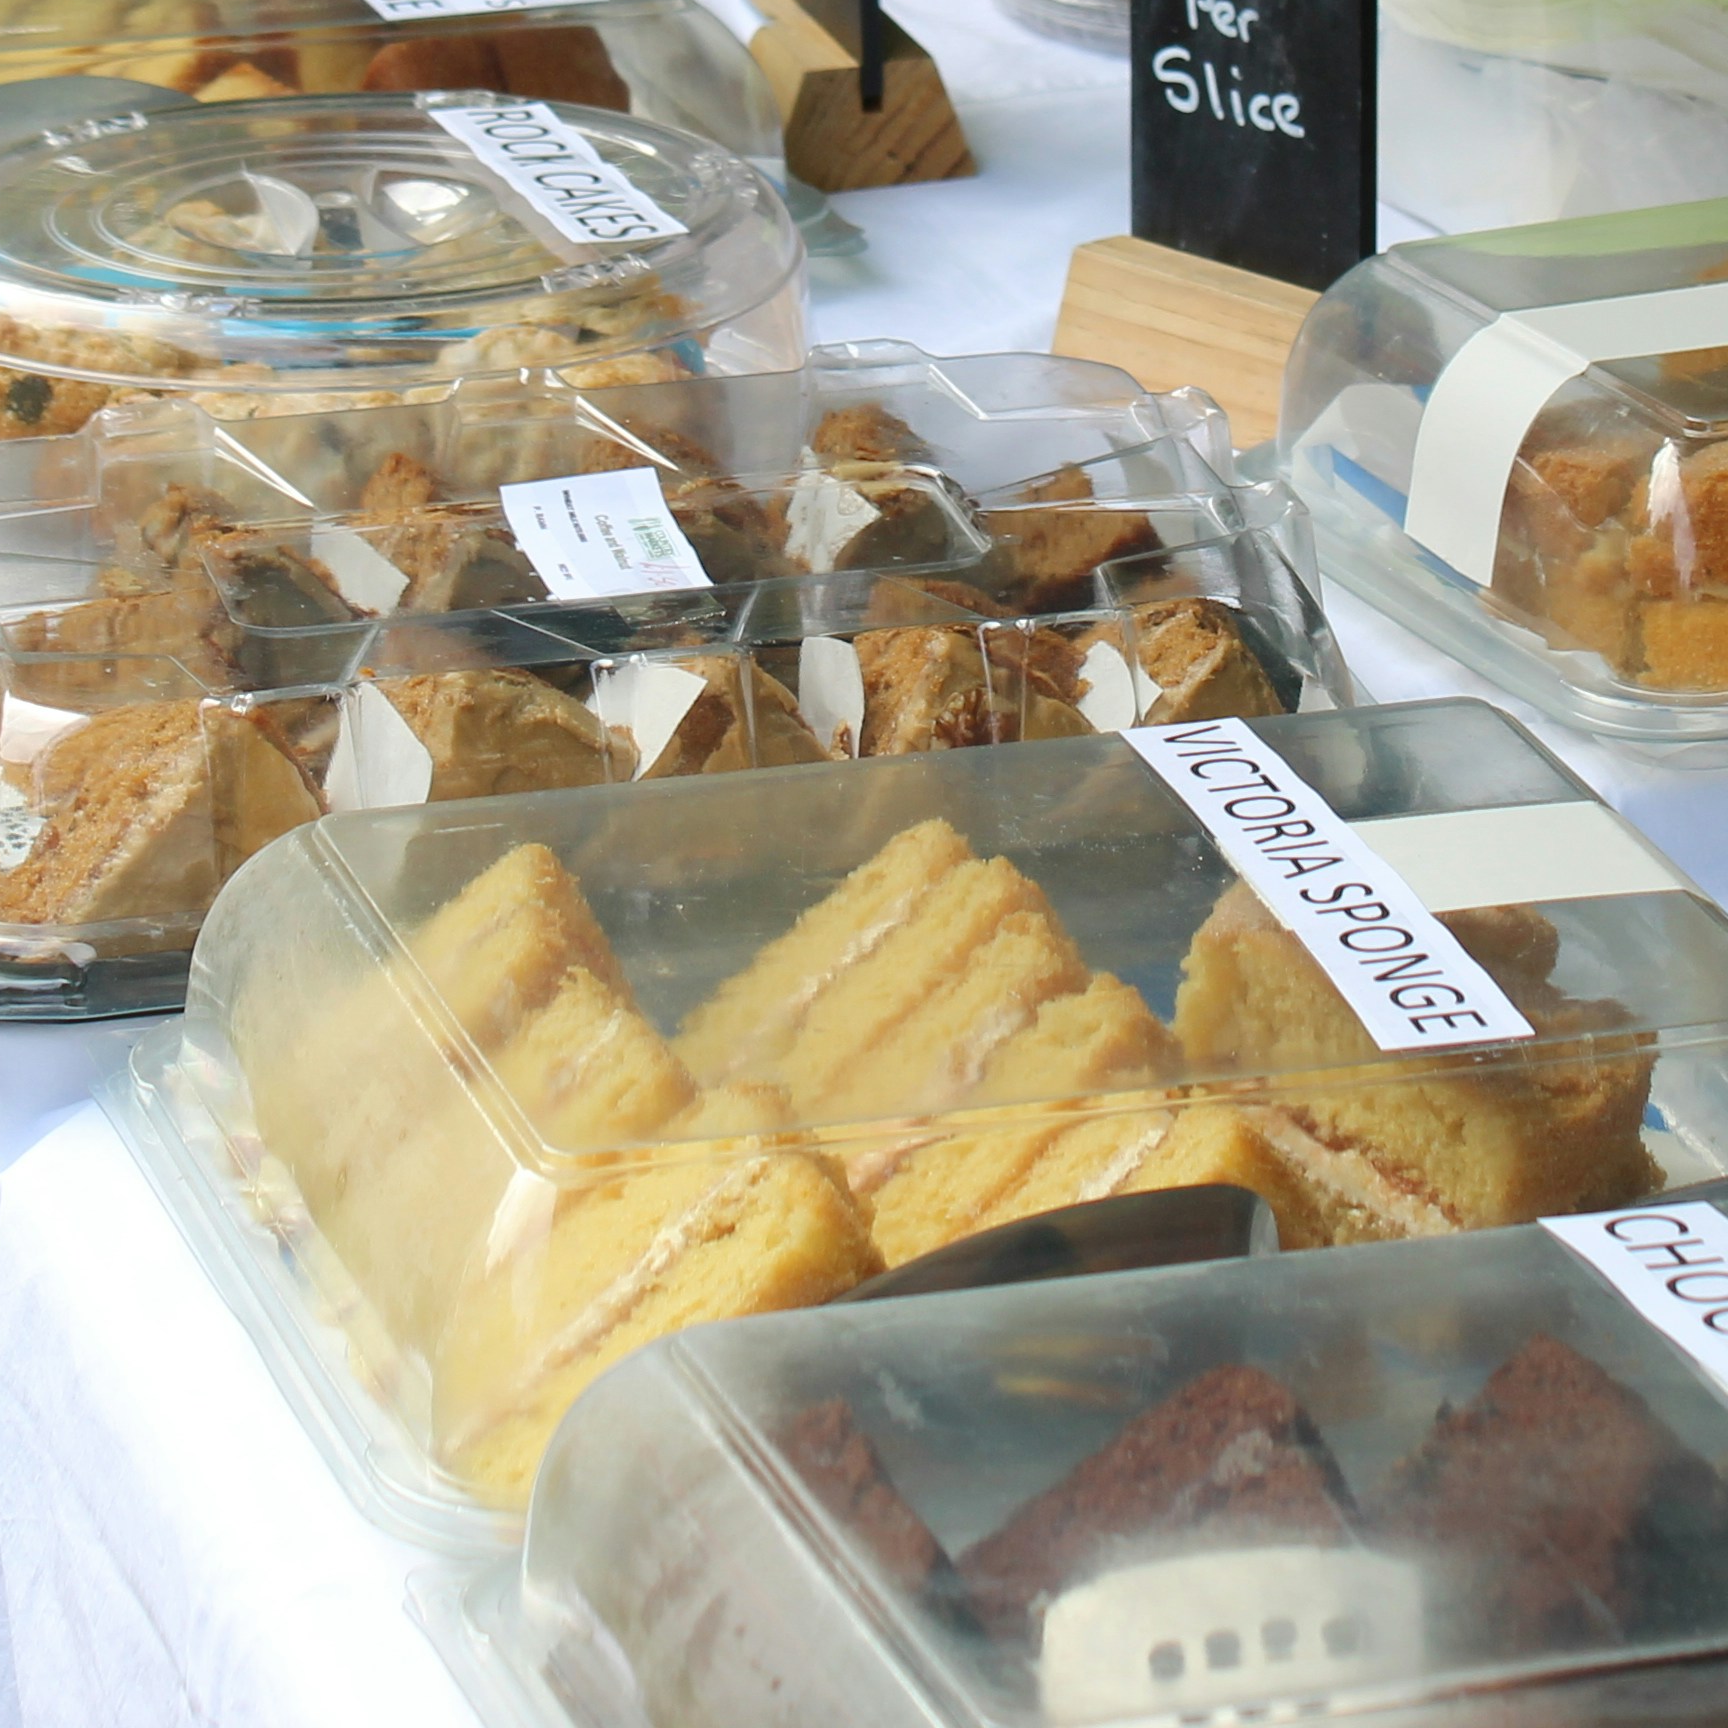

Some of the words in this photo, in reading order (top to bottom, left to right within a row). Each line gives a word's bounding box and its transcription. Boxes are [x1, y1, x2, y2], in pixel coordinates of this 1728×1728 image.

[1152, 46, 1305, 138] Slice
[468, 109, 575, 167] ROCK
[535, 171, 658, 239] CAKES
[594, 514, 614, 536] Coffee
[604, 536, 623, 548] and
[1163, 724, 1343, 879] VICTORIA
[1300, 881, 1488, 1034] SPONGE
